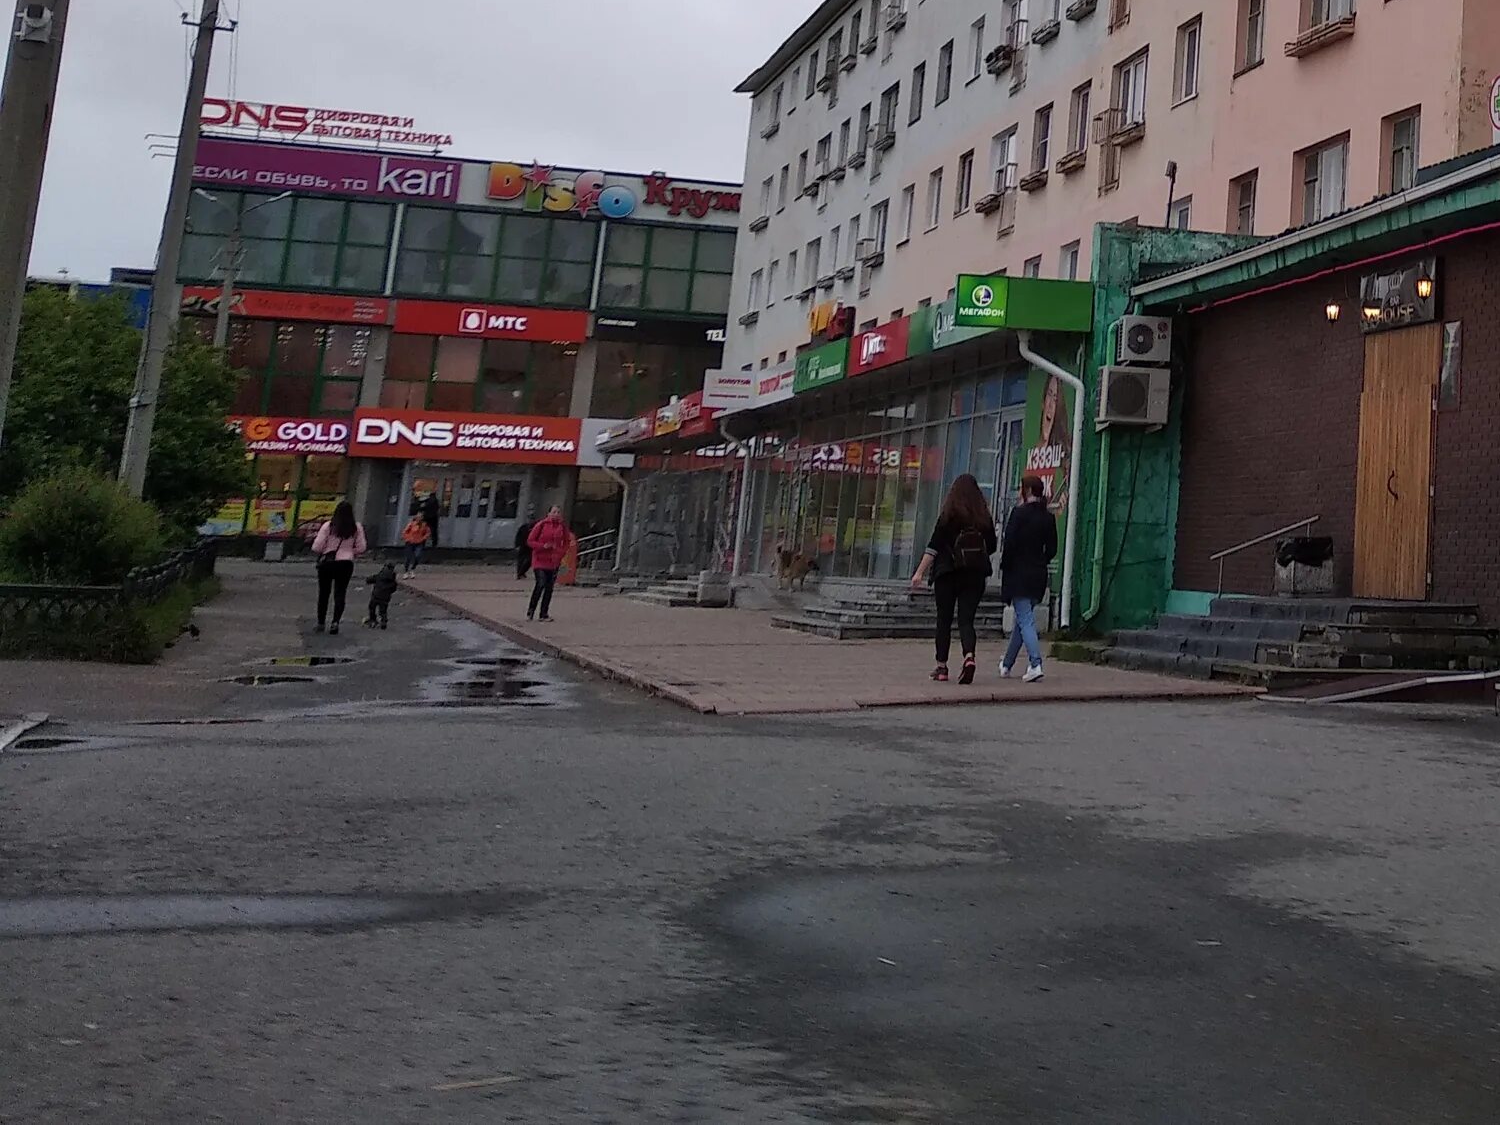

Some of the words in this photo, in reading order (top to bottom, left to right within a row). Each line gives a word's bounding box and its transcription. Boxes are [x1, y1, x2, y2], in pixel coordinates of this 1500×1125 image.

[200, 98, 308, 132] DNS
[314, 108, 399, 127] ЦИФРОВАЯ
[312, 124, 381, 139] БЫТОВАЯ
[386, 130, 453, 145] ТЕХНИКА
[192, 165, 249, 181] ЕСЛИ
[377, 156, 455, 197] kari
[488, 315, 528, 331] МТС
[277, 421, 348, 442] GOLD
[356, 417, 455, 447] DNS
[457, 423, 530, 438] ЦИФРОВАЯ
[456, 435, 516, 450] БЫТОВАЯ
[517, 439, 575, 452] ТЕХНИКА
